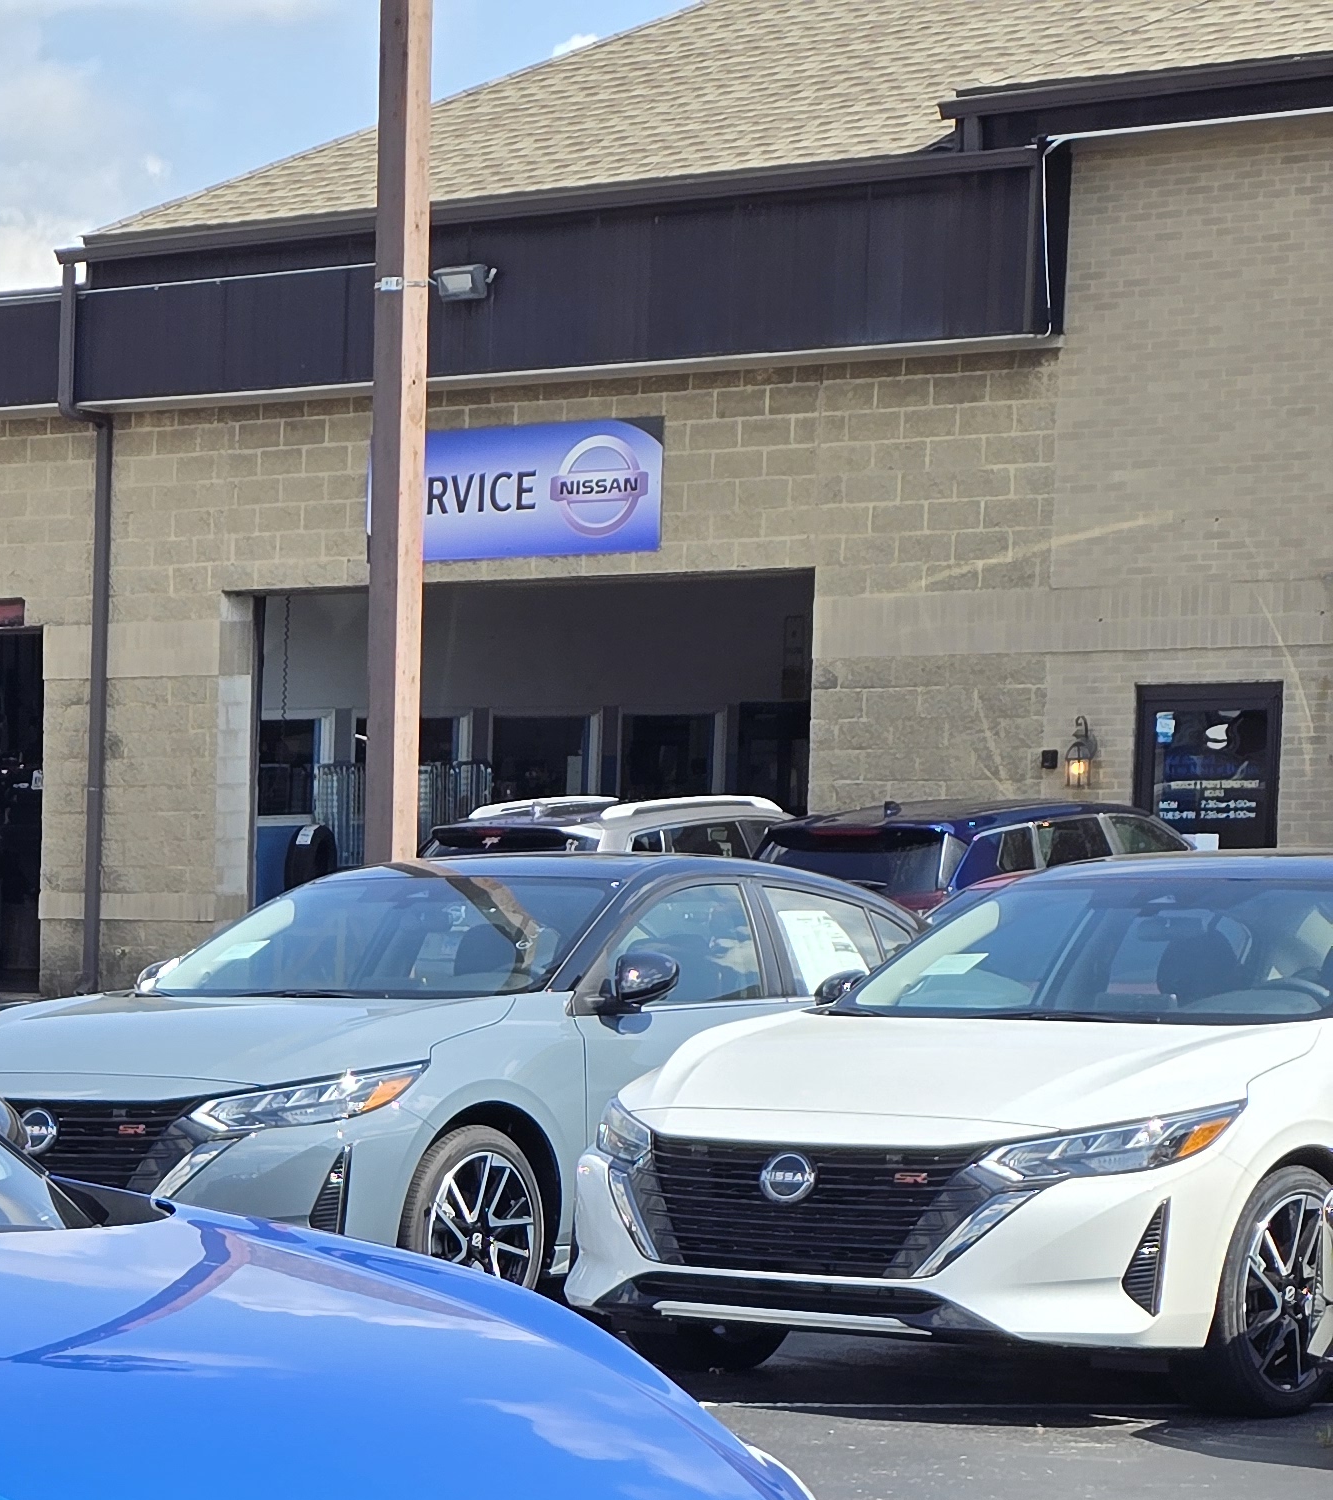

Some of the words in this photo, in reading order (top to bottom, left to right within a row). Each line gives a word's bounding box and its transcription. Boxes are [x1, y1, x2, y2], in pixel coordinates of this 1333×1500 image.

[427, 470, 537, 515] RVICE
[559, 477, 638, 496] NISSAN
[118, 1124, 145, 1134] SR
[762, 1170, 814, 1183] NISSAN
[894, 1172, 927, 1183] SR
